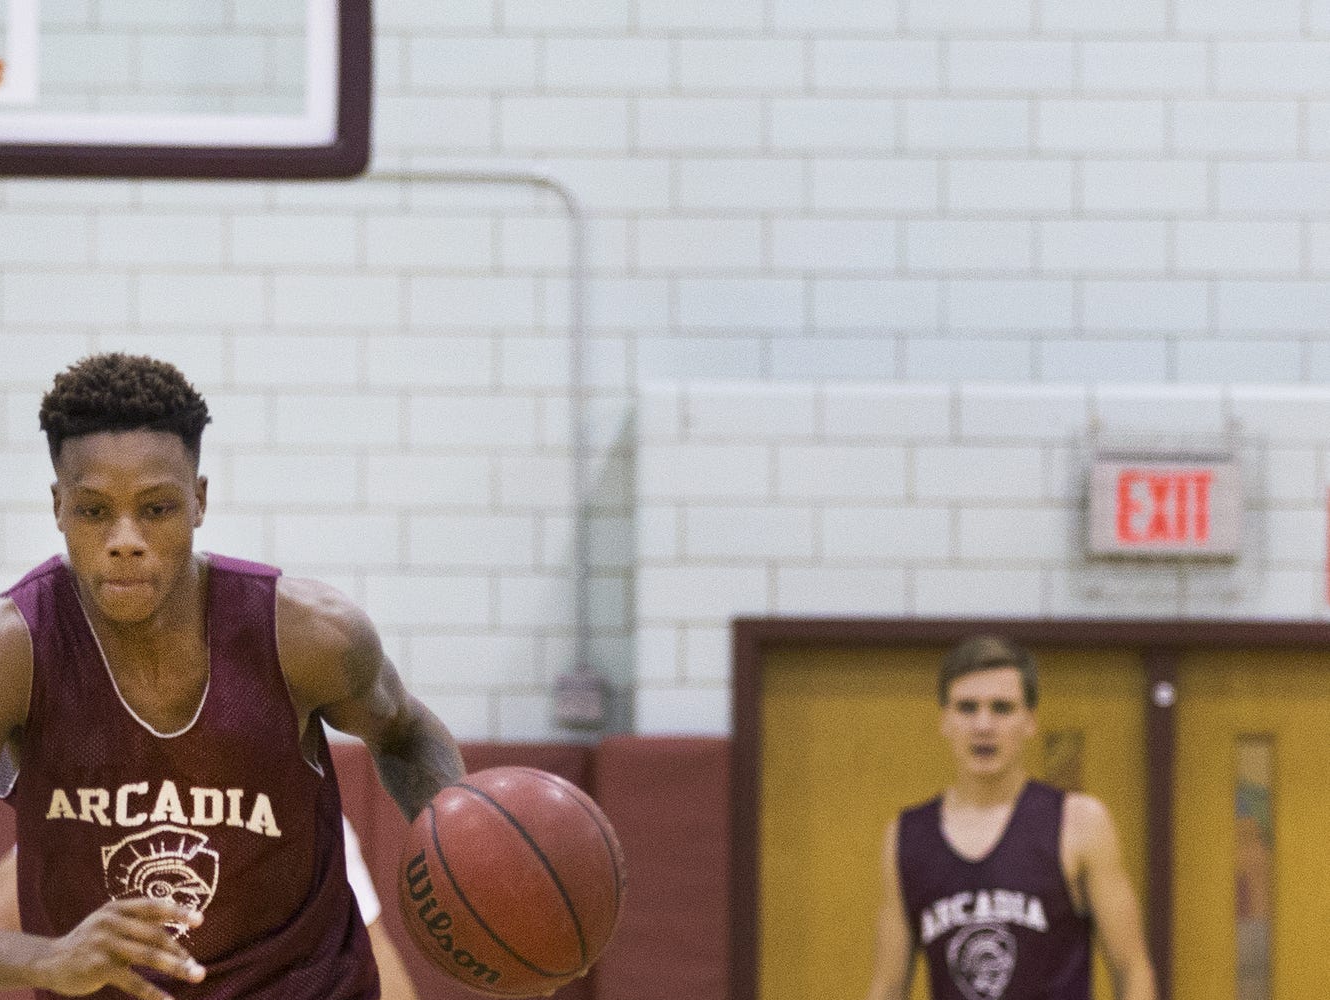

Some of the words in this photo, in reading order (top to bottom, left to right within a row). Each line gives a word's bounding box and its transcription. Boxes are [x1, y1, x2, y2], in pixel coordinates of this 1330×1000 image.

[1116, 470, 1213, 544] EXIT
[46, 780, 282, 837] ARCADIA
[406, 849, 502, 984] Wilson
[921, 888, 1049, 944] ARCADIA
